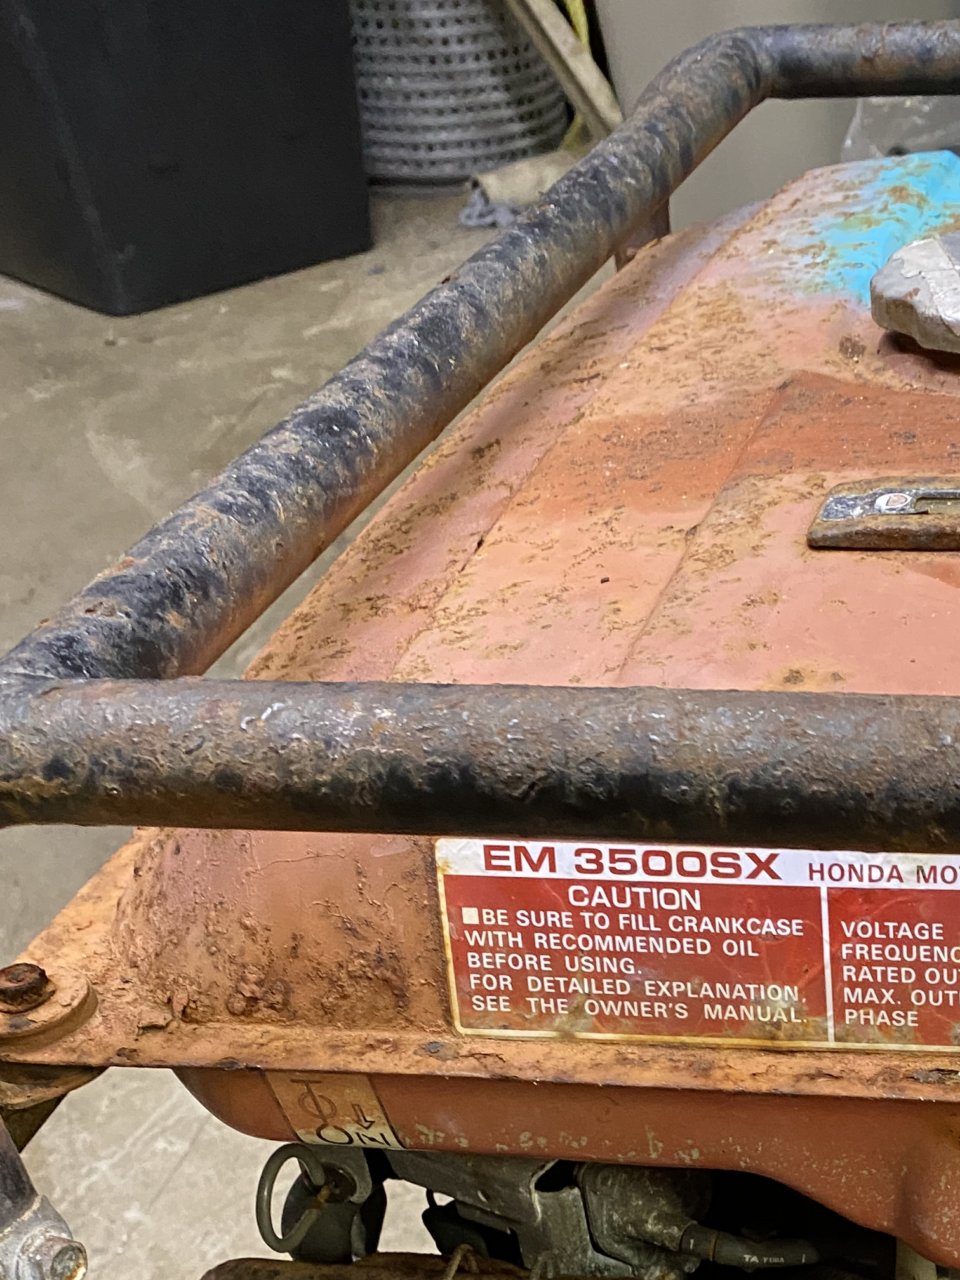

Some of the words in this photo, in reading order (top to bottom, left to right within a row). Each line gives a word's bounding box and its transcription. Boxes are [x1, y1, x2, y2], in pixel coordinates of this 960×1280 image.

[483, 845, 556, 874] EM
[574, 848, 781, 880] 3500SX
[808, 863, 904, 883] HONDA
[568, 885, 700, 911] CAUTION
[482, 909, 508, 925] BE
[516, 911, 573, 929] SURE
[581, 913, 609, 929] TO
[619, 915, 660, 932] FILL
[669, 916, 804, 936] CRANKCASE
[841, 921, 944, 941] VOLTAGE
[464, 931, 522, 948] WITH
[534, 933, 711, 956] RECOMMENDED
[723, 938, 759, 957] OIL
[467, 953, 552, 971] BEFORE
[565, 956, 642, 975] USING.
[470, 974, 512, 991] FOR
[527, 976, 630, 995] DETAILED
[843, 966, 918, 985] RATED
[844, 988, 901, 1006] MAX.
[472, 995, 511, 1012] SEE
[526, 998, 568, 1014] THE
[584, 1000, 688, 1018] OWNER'S
[704, 1004, 808, 1023] MANUAL.
[845, 1008, 918, 1027] PHASE
